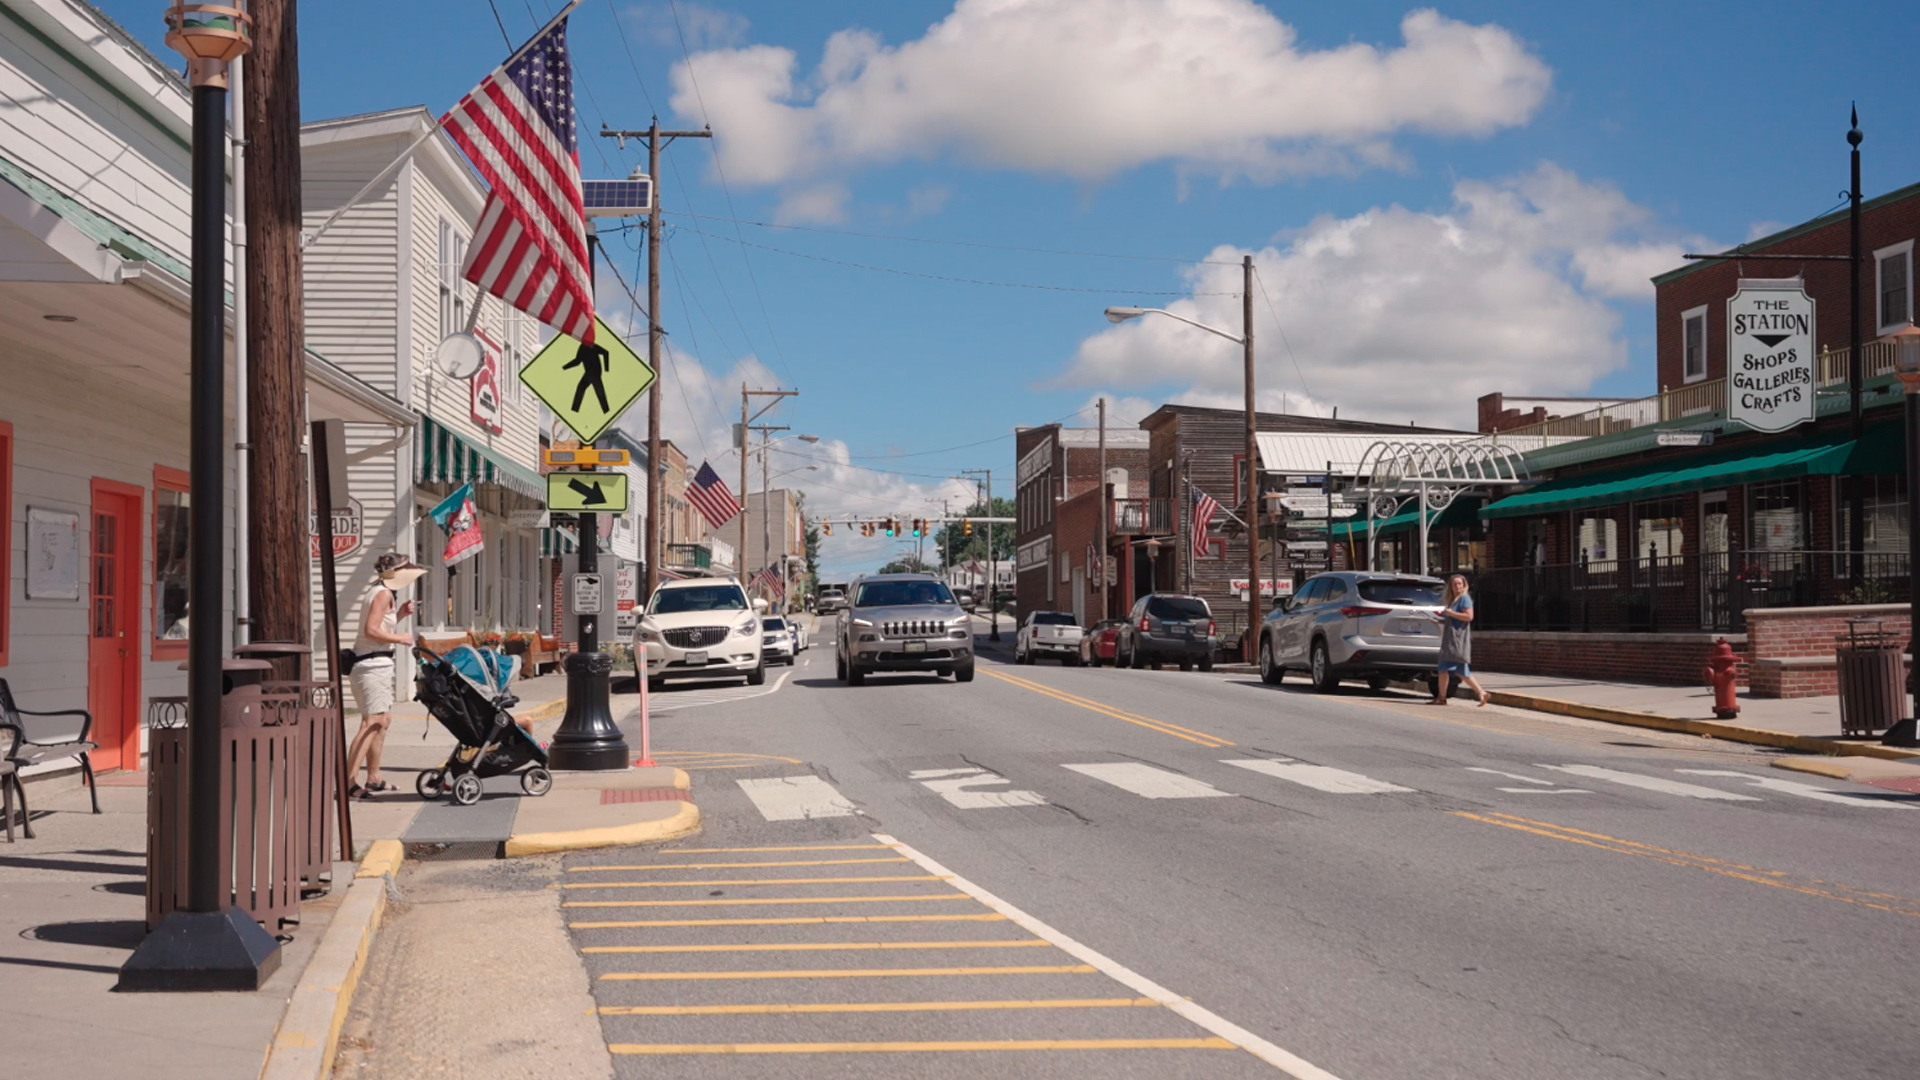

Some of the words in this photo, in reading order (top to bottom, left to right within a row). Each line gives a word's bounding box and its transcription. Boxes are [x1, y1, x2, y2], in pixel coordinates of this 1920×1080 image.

[1753, 300, 1790, 310] THE
[1734, 313, 1809, 335] STATION
[1742, 348, 1798, 371] SHOPS
[1733, 367, 1811, 391] GALLERIES
[1741, 386, 1802, 414] CRAFTS
[1267, 581, 1290, 589] Sles
